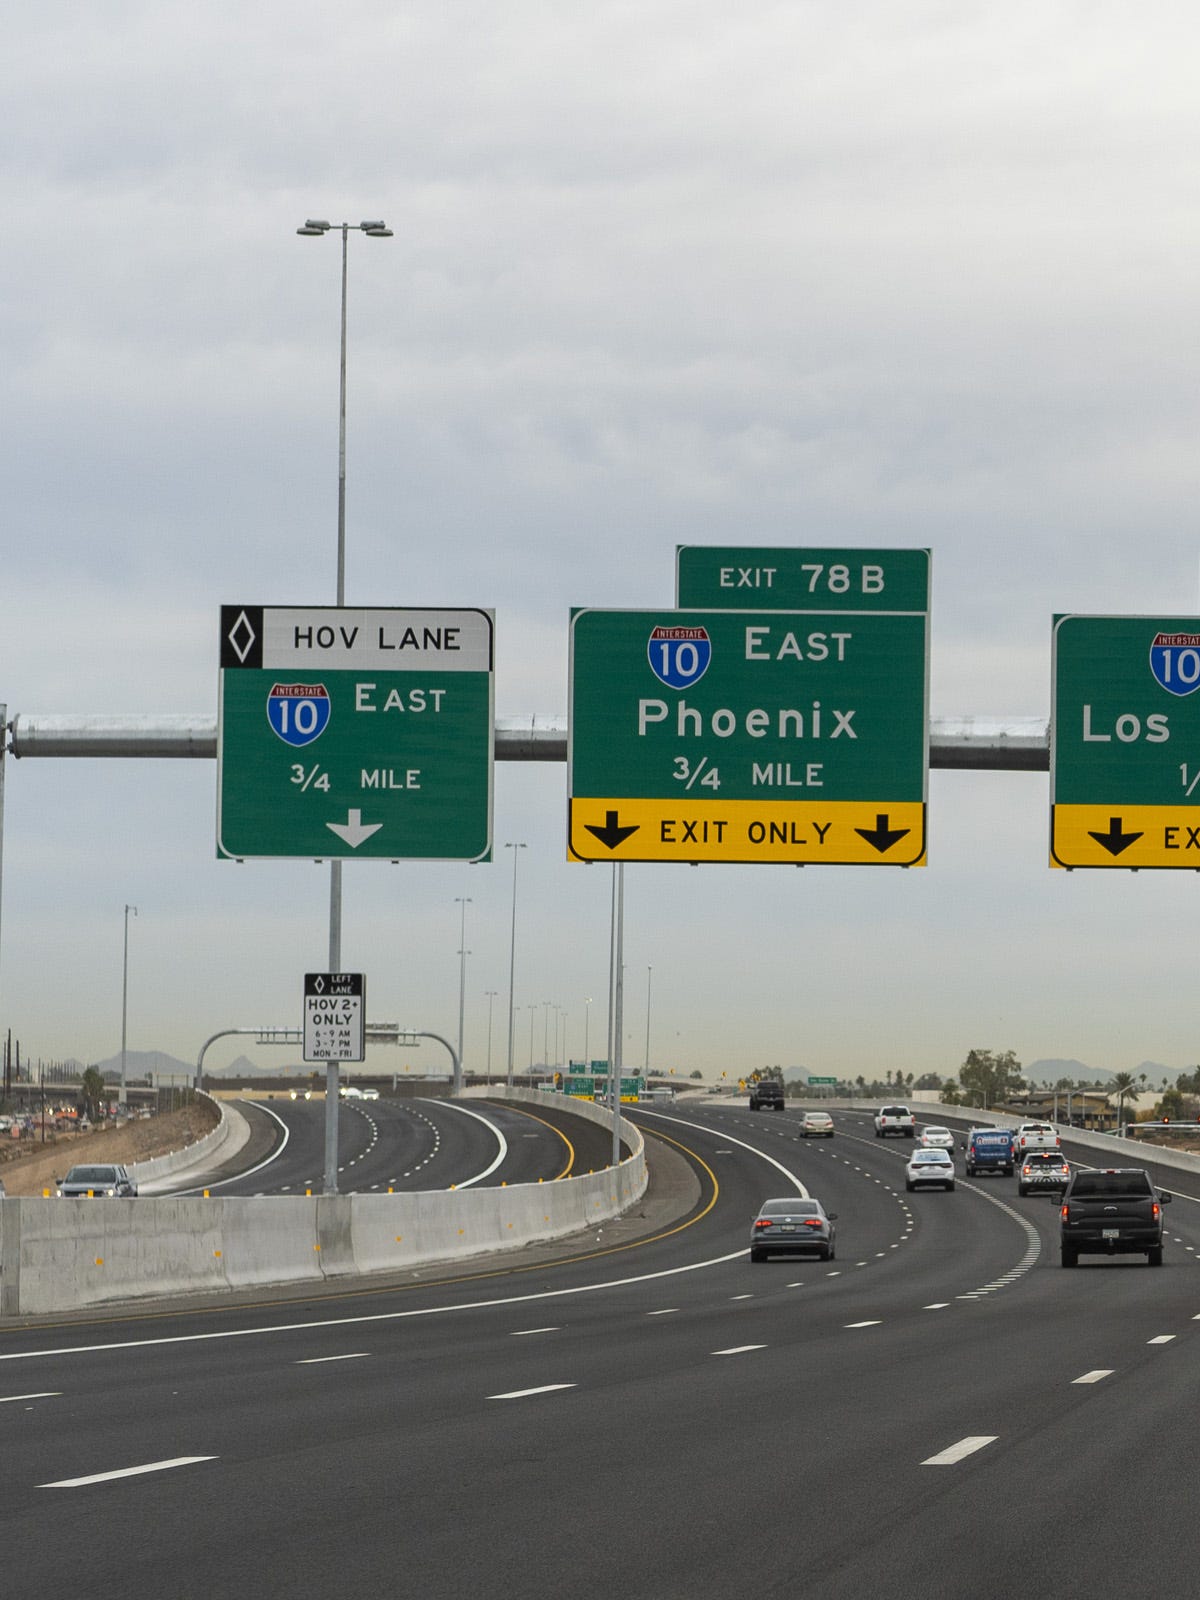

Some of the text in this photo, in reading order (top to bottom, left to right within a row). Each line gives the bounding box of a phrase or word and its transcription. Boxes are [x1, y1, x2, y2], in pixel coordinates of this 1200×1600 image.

[721, 568, 776, 587] EXIT
[295, 626, 460, 650] HOV LANE
[657, 630, 703, 639] INTERSTATE
[746, 627, 851, 660] EAST
[660, 643, 699, 677] 10
[1162, 649, 1200, 684] 10
[276, 686, 322, 697] INTERSTATE
[356, 684, 446, 712] EAST
[279, 700, 318, 734] 10
[639, 699, 857, 738] Phoenix
[1083, 705, 1169, 742] Los
[362, 769, 420, 789] MILE
[753, 763, 823, 786] MILE
[661, 821, 832, 844] EXIT ONLY
[330, 986, 352, 994] LANE
[331, 975, 351, 983] LEFT
[308, 998, 338, 1010] HOV
[312, 1013, 353, 1025] ONLY
